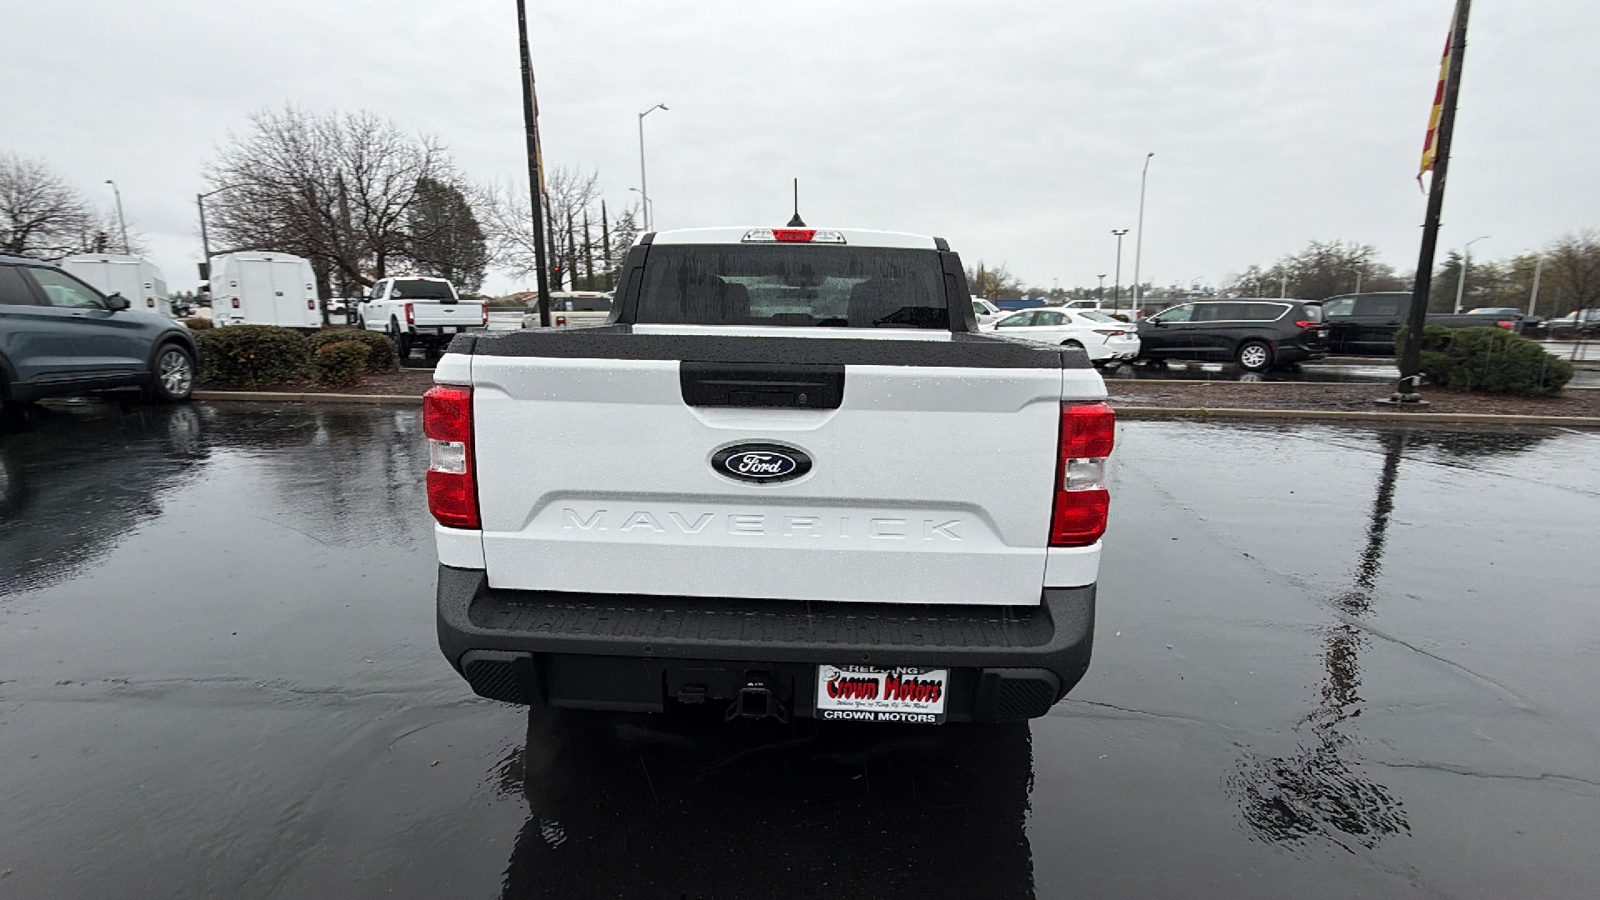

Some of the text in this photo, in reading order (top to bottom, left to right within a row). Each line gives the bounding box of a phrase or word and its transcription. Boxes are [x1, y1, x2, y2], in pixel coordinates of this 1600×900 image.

[738, 453, 782, 474] Ford
[562, 507, 963, 542] MAVERICK
[849, 665, 918, 675] REDNG
[827, 674, 942, 703] Crown Motors
[824, 710, 936, 723] CROWN MOTORS
